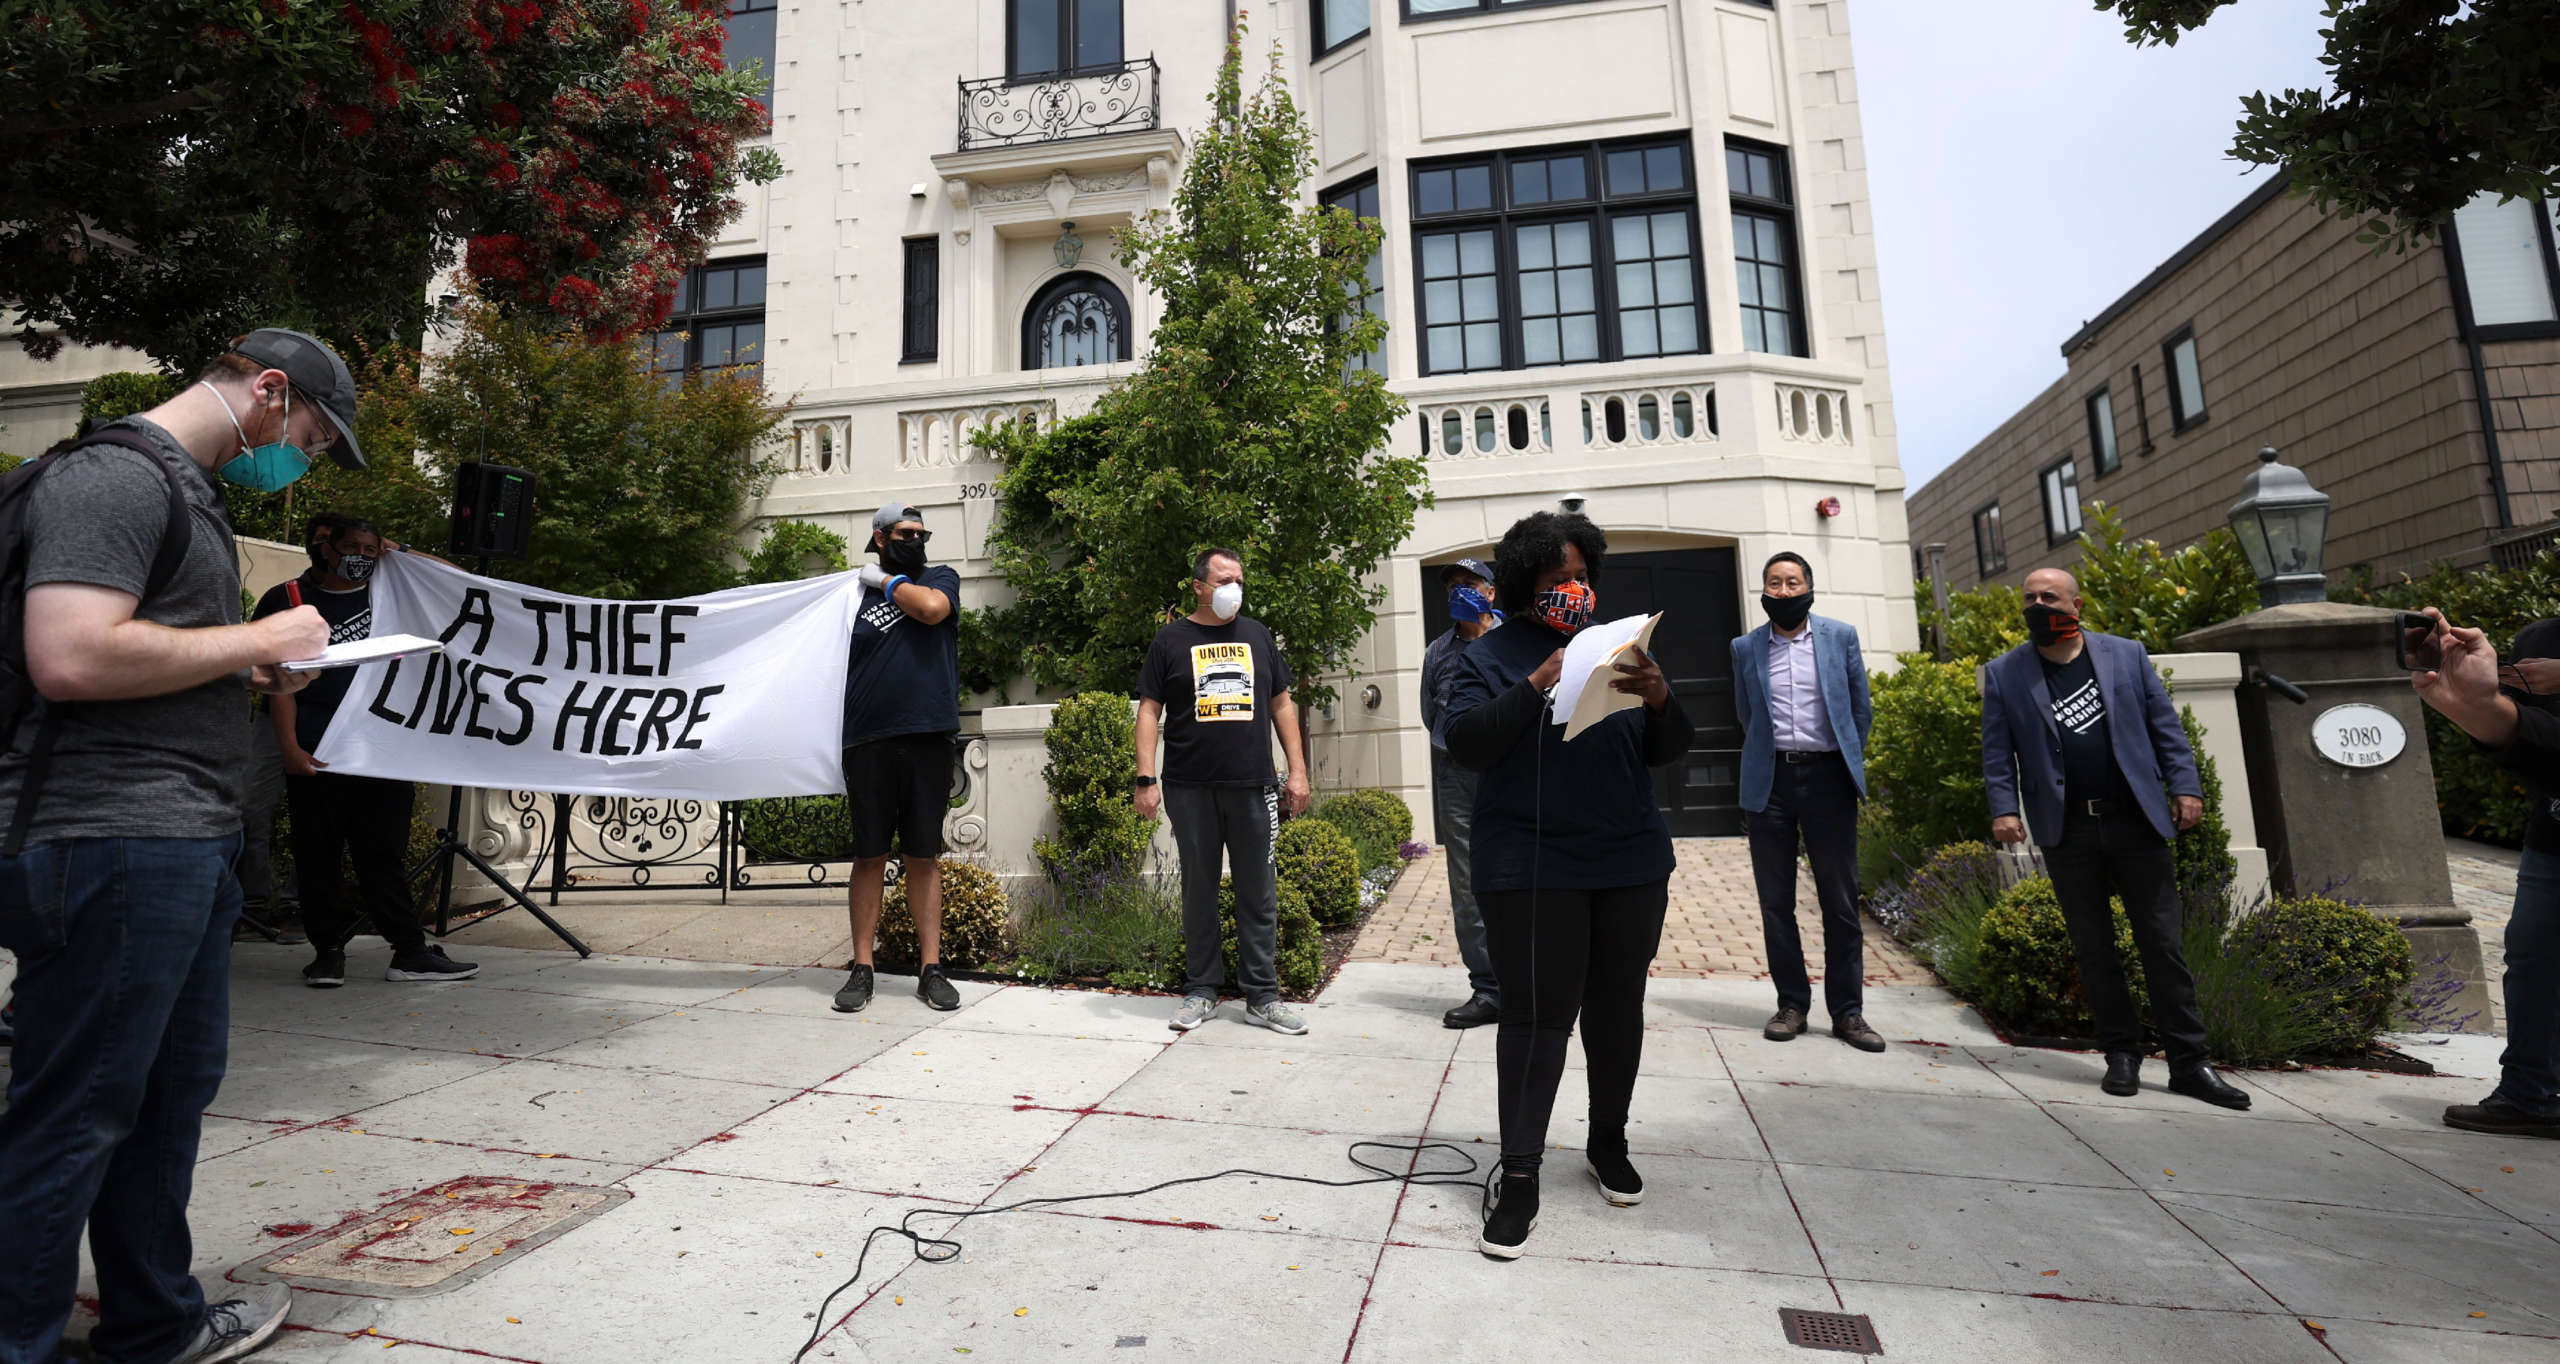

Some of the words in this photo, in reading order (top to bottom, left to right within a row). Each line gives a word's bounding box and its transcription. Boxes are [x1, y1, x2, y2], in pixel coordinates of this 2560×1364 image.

[866, 604, 897, 622] WORK
[438, 588, 494, 656] A
[521, 598, 699, 676] THIEF
[1200, 645, 1245, 660] UNIONS
[368, 652, 548, 746] LIVES
[552, 681, 724, 756] HERE
[1199, 704, 1218, 716] WE
[2055, 683, 2100, 722] WORKER
[2064, 699, 2102, 728] RISING
[2339, 726, 2382, 747] 3080
[2359, 751, 2385, 764] BACK
